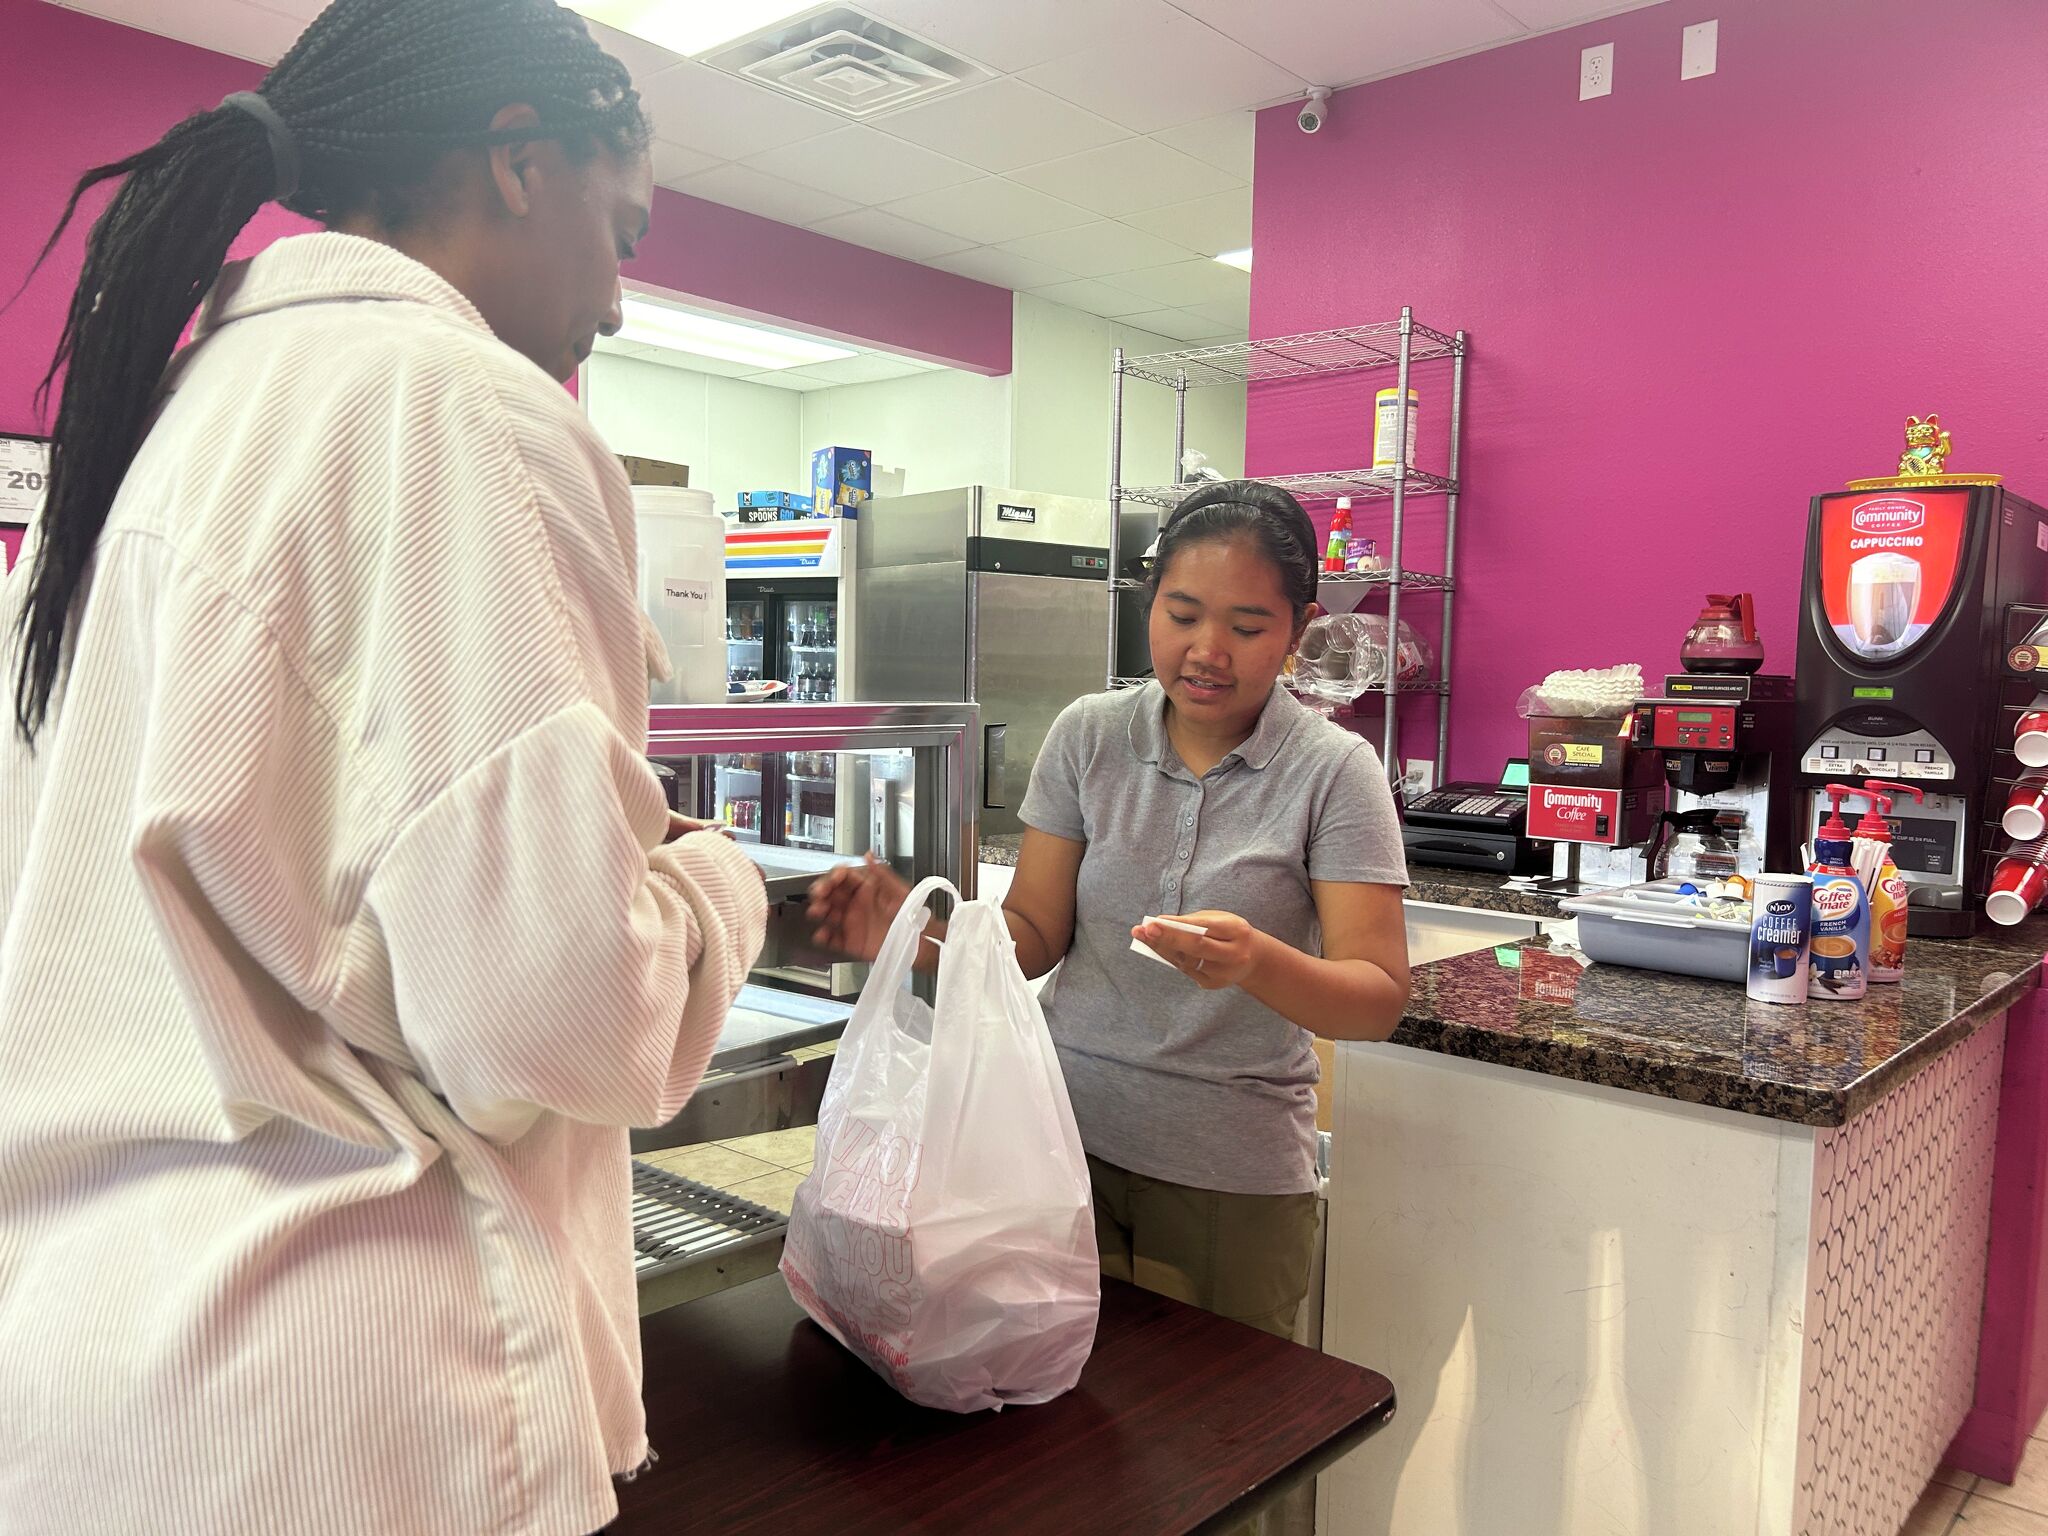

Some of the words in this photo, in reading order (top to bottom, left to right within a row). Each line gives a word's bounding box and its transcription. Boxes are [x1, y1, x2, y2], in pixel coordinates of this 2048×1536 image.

[748, 511, 778, 522] SPOONS
[1855, 509, 1920, 525] Community
[1850, 536, 1923, 550] CAPPUCCINO
[666, 588, 689, 599] Thank
[690, 591, 703, 600] You
[1544, 789, 1602, 812] Community
[1557, 806, 1587, 822] Coffee
[1813, 887, 1852, 903] Coffee
[1820, 900, 1850, 910] mate
[1762, 915, 1797, 930] COFFEE
[1757, 926, 1802, 945] creamer
